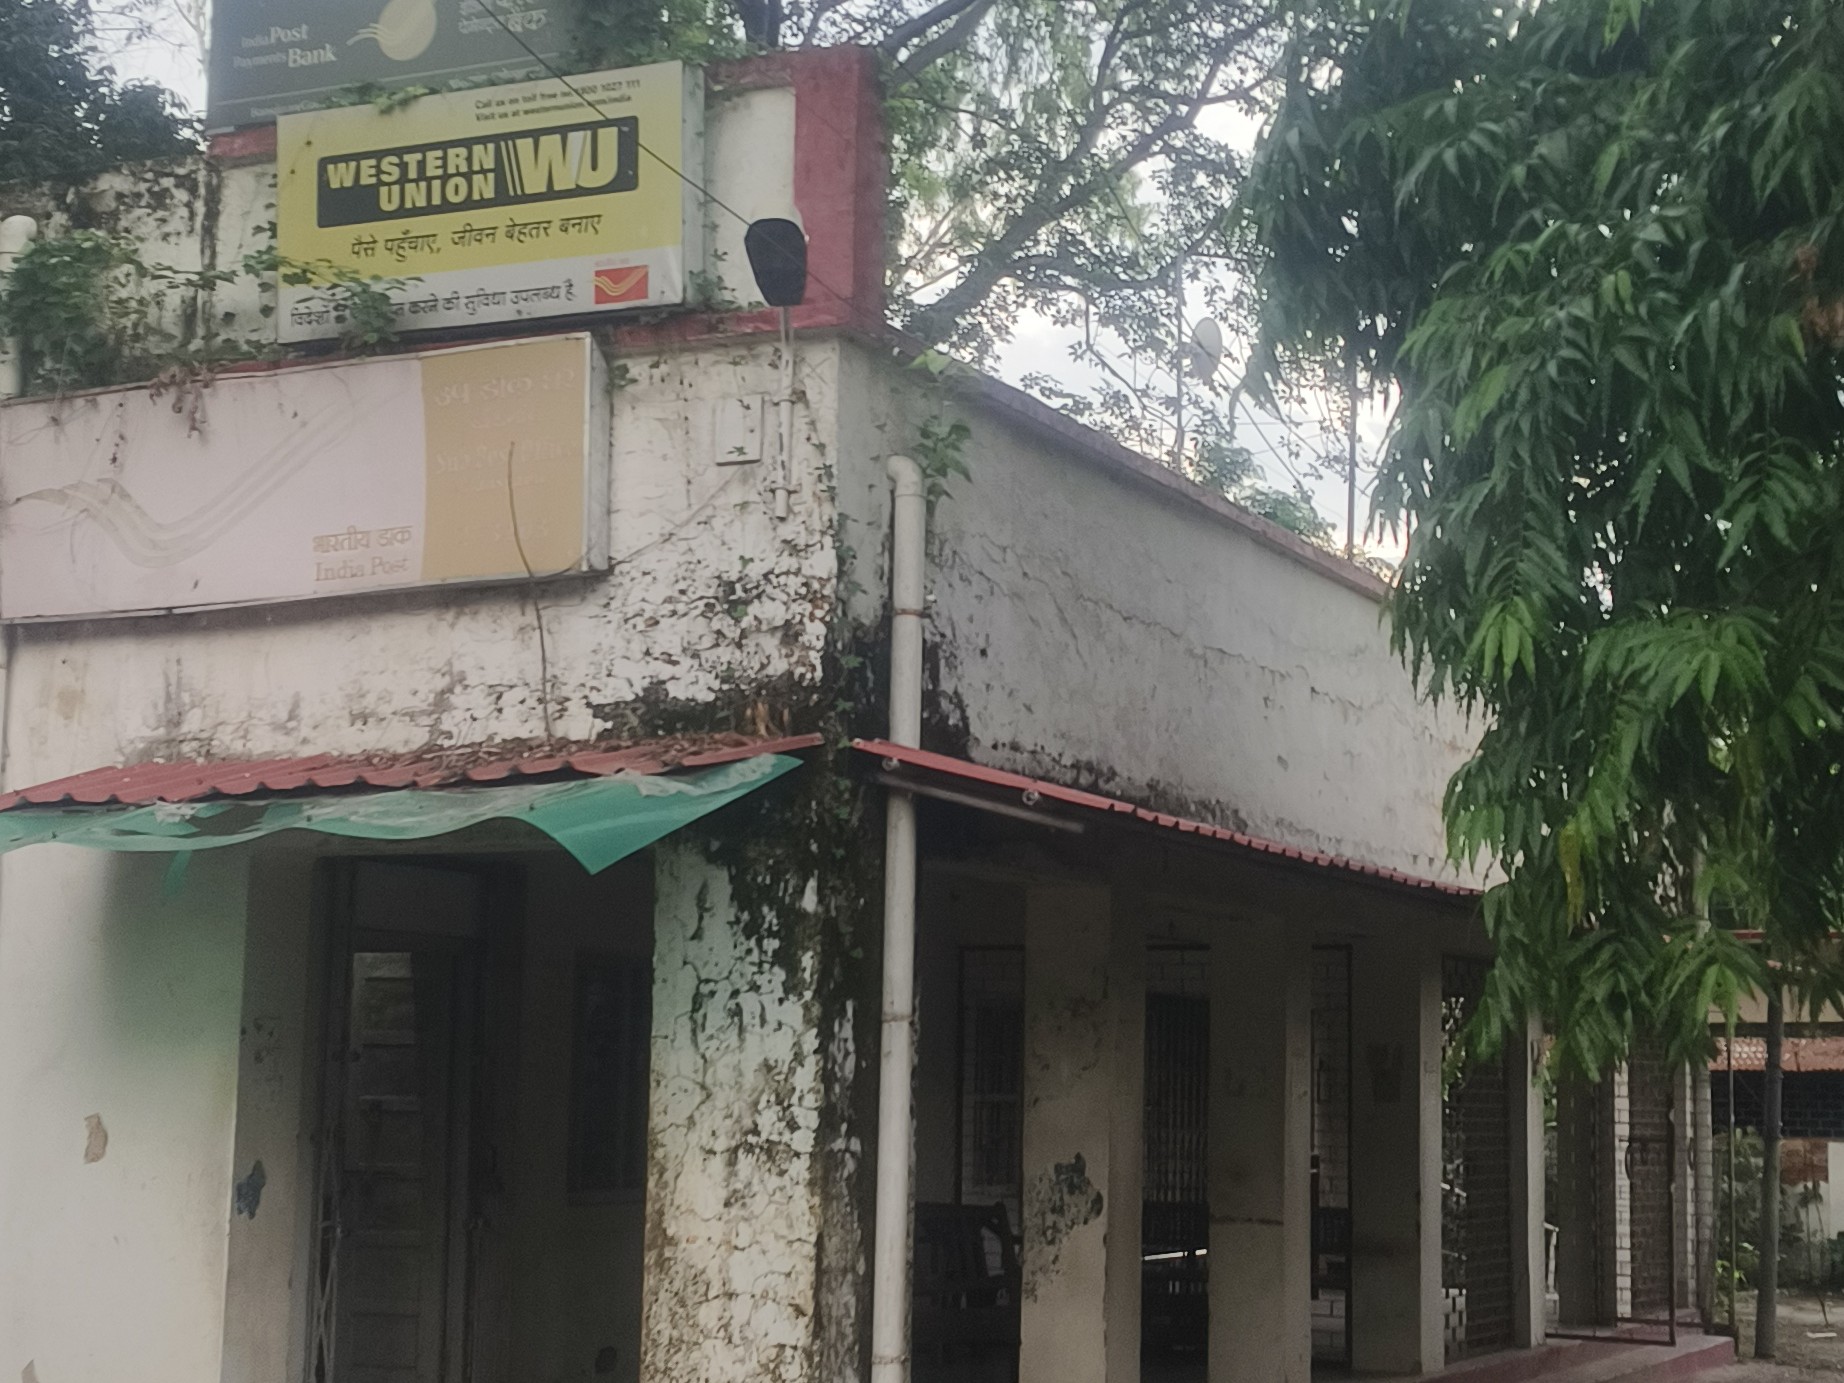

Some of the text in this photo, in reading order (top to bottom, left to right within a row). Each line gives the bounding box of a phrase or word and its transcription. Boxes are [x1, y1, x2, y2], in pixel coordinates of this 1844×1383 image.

[270, 23, 309, 43] Post
[287, 43, 337, 68] Bank
[327, 126, 619, 195] WESTERN WU
[379, 172, 495, 212] UNION
[351, 233, 378, 259] पैसे
[451, 223, 498, 248] जीवन
[504, 217, 553, 244] बेहतर
[312, 525, 413, 553] भारतीय डाक
[314, 556, 409, 581] India Post
